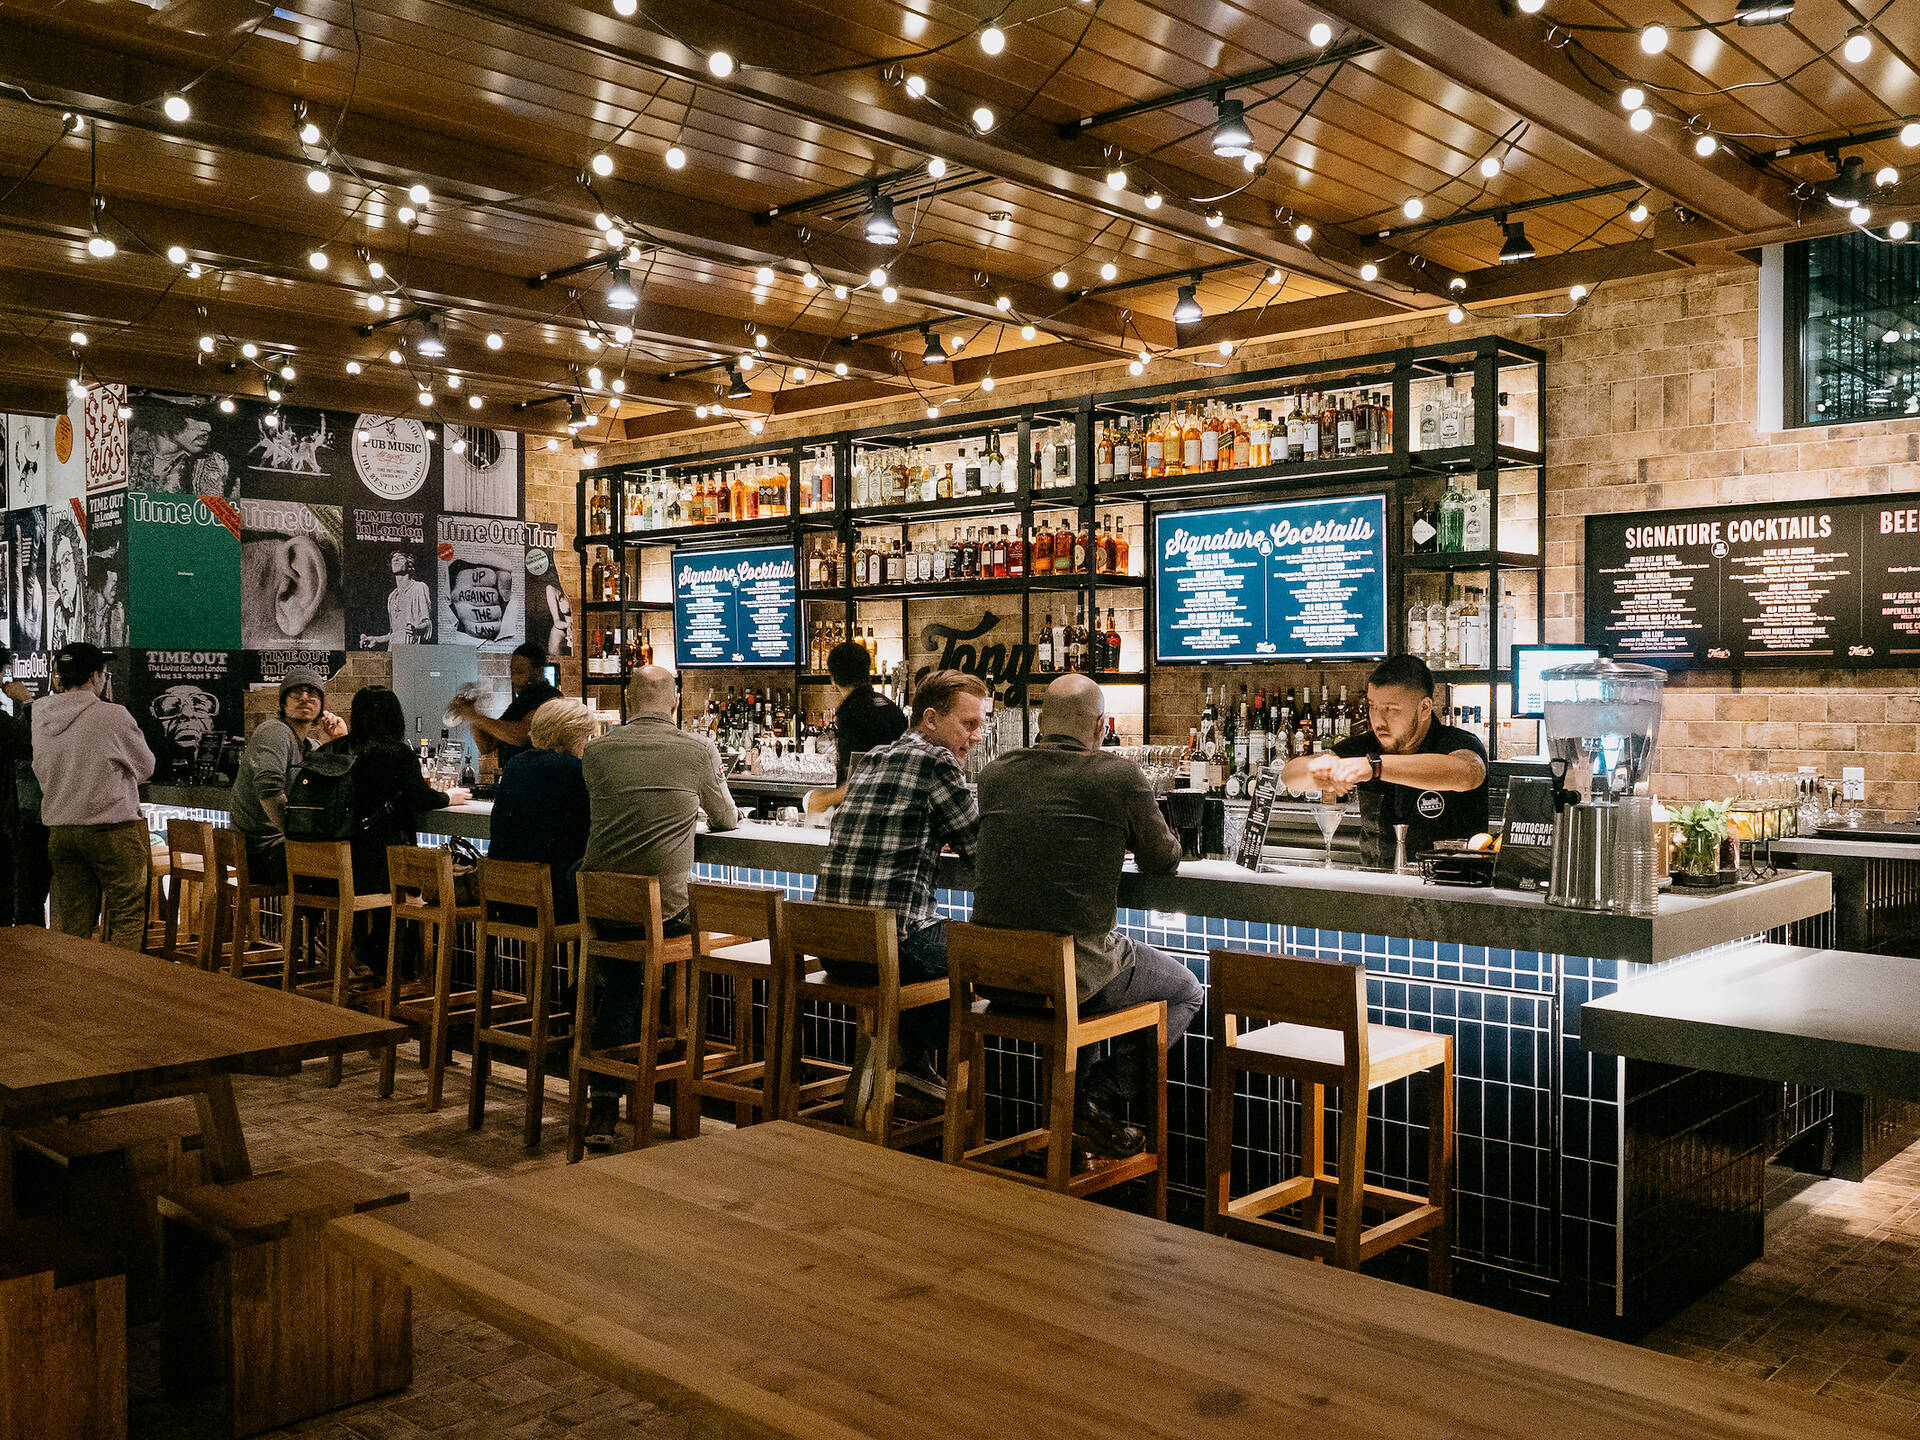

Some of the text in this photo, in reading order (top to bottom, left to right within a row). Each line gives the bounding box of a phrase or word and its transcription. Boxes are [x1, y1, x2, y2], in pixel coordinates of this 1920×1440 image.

[388, 441, 422, 453] MUSIC
[89, 493, 125, 513] TIME OUT
[128, 492, 192, 525] Time
[240, 500, 298, 531] Time
[353, 508, 393, 523] TIME
[393, 512, 424, 526] OUT
[1880, 509, 1920, 534] BEE
[355, 521, 424, 538] in London
[438, 515, 525, 545] Time Out
[1625, 522, 1721, 549] SIGNATURE
[1727, 514, 1832, 543] COCKTAILS
[1165, 517, 1375, 560] Signature Cocktails
[472, 570, 486, 584] UP
[678, 560, 795, 589] Signature Cocktails
[459, 590, 496, 604] AGAINST
[472, 608, 491, 621] THE
[475, 625, 496, 635] LAW
[146, 651, 228, 665] TIME OUT
[258, 650, 331, 663] TIME OUT
[12, 652, 48, 678] Time Out
[161, 664, 179, 672] Living
[260, 661, 276, 675] in
[1511, 821, 1554, 834] PHOTOGRAP
[1510, 832, 1551, 846] TAKING PLA
